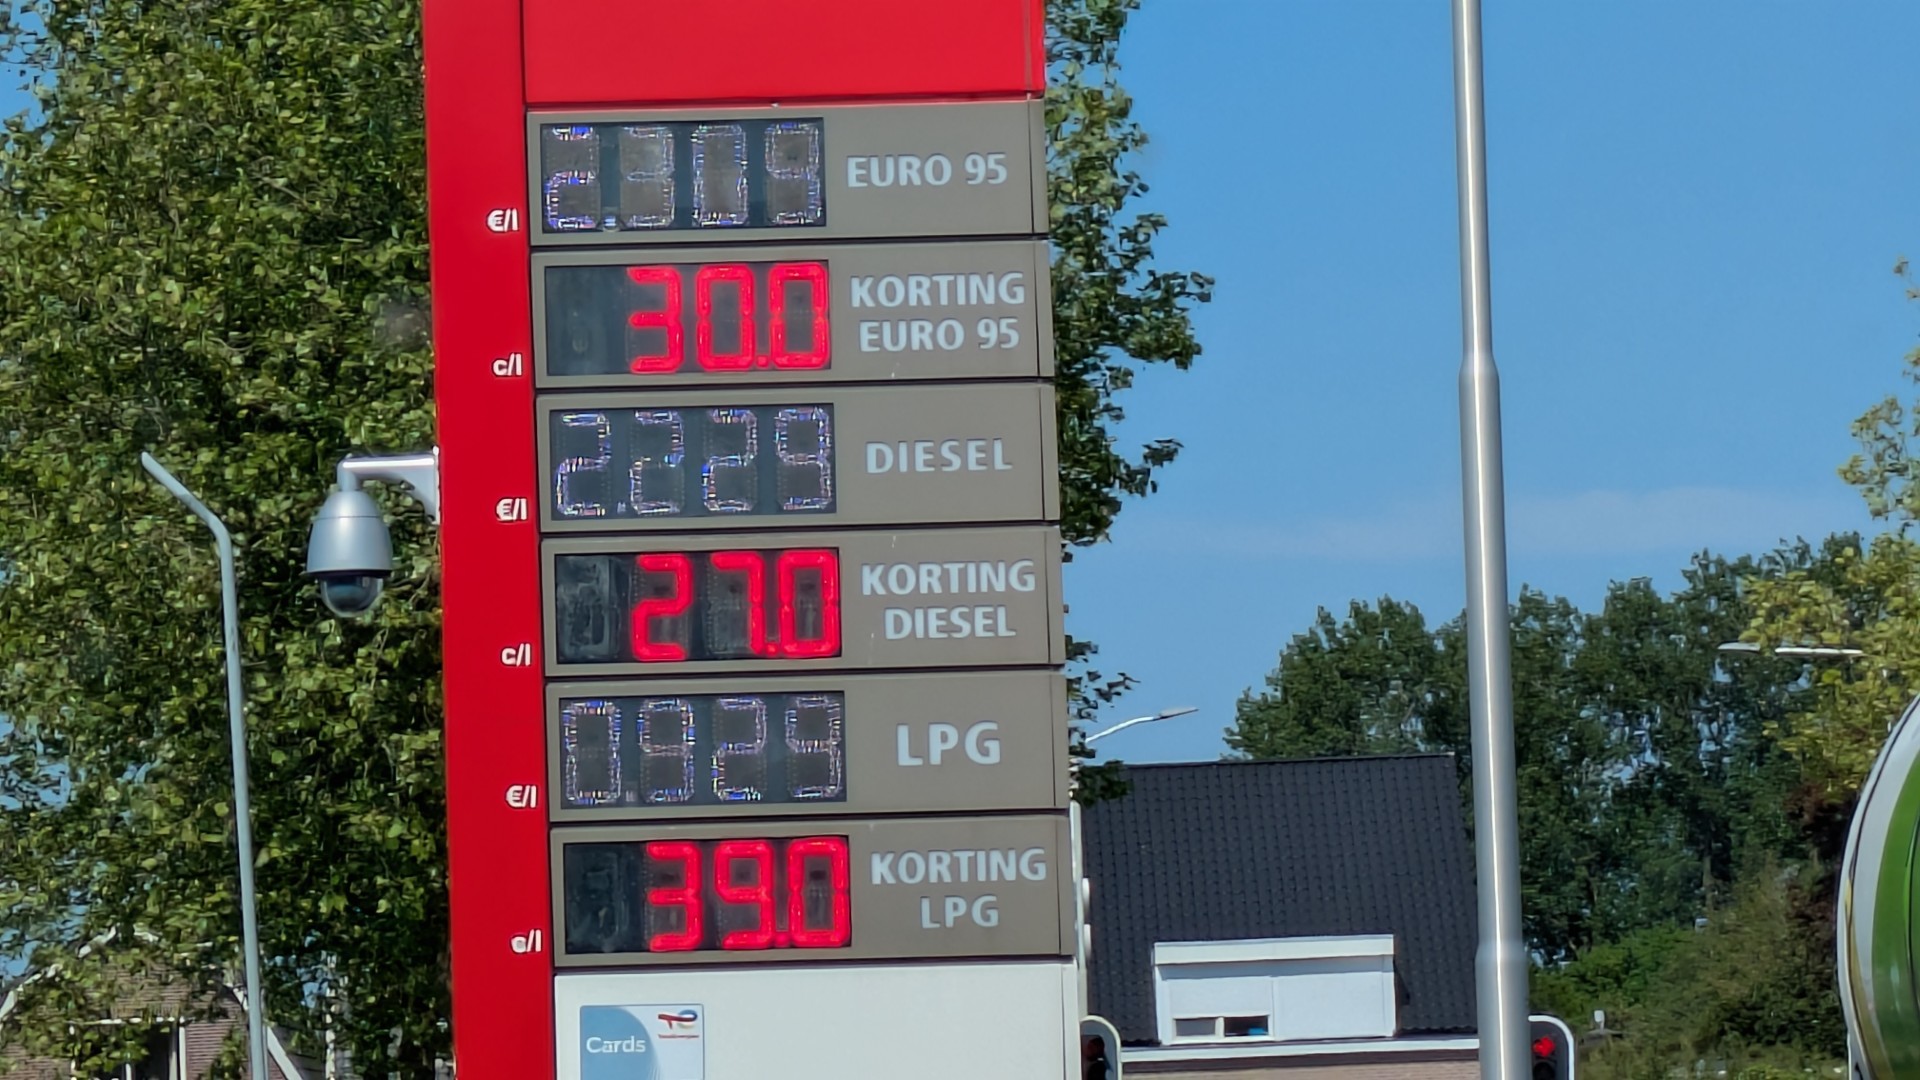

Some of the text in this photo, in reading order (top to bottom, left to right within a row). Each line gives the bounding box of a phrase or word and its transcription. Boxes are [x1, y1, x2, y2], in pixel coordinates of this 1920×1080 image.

[847, 153, 1008, 188] EURO 95
[851, 271, 1025, 309] KORTING
[627, 261, 831, 375] 30.0
[859, 317, 1019, 353] EURO 95
[866, 439, 1012, 475] DIESEL
[862, 560, 1037, 597] KORTING
[632, 549, 840, 662] 27.0
[885, 606, 1017, 641] DIESEL
[897, 721, 1002, 767] LPG
[871, 847, 1047, 886] KORTING
[646, 837, 850, 953] 39.0
[921, 895, 998, 930] LPG
[586, 1035, 647, 1054] Cards
